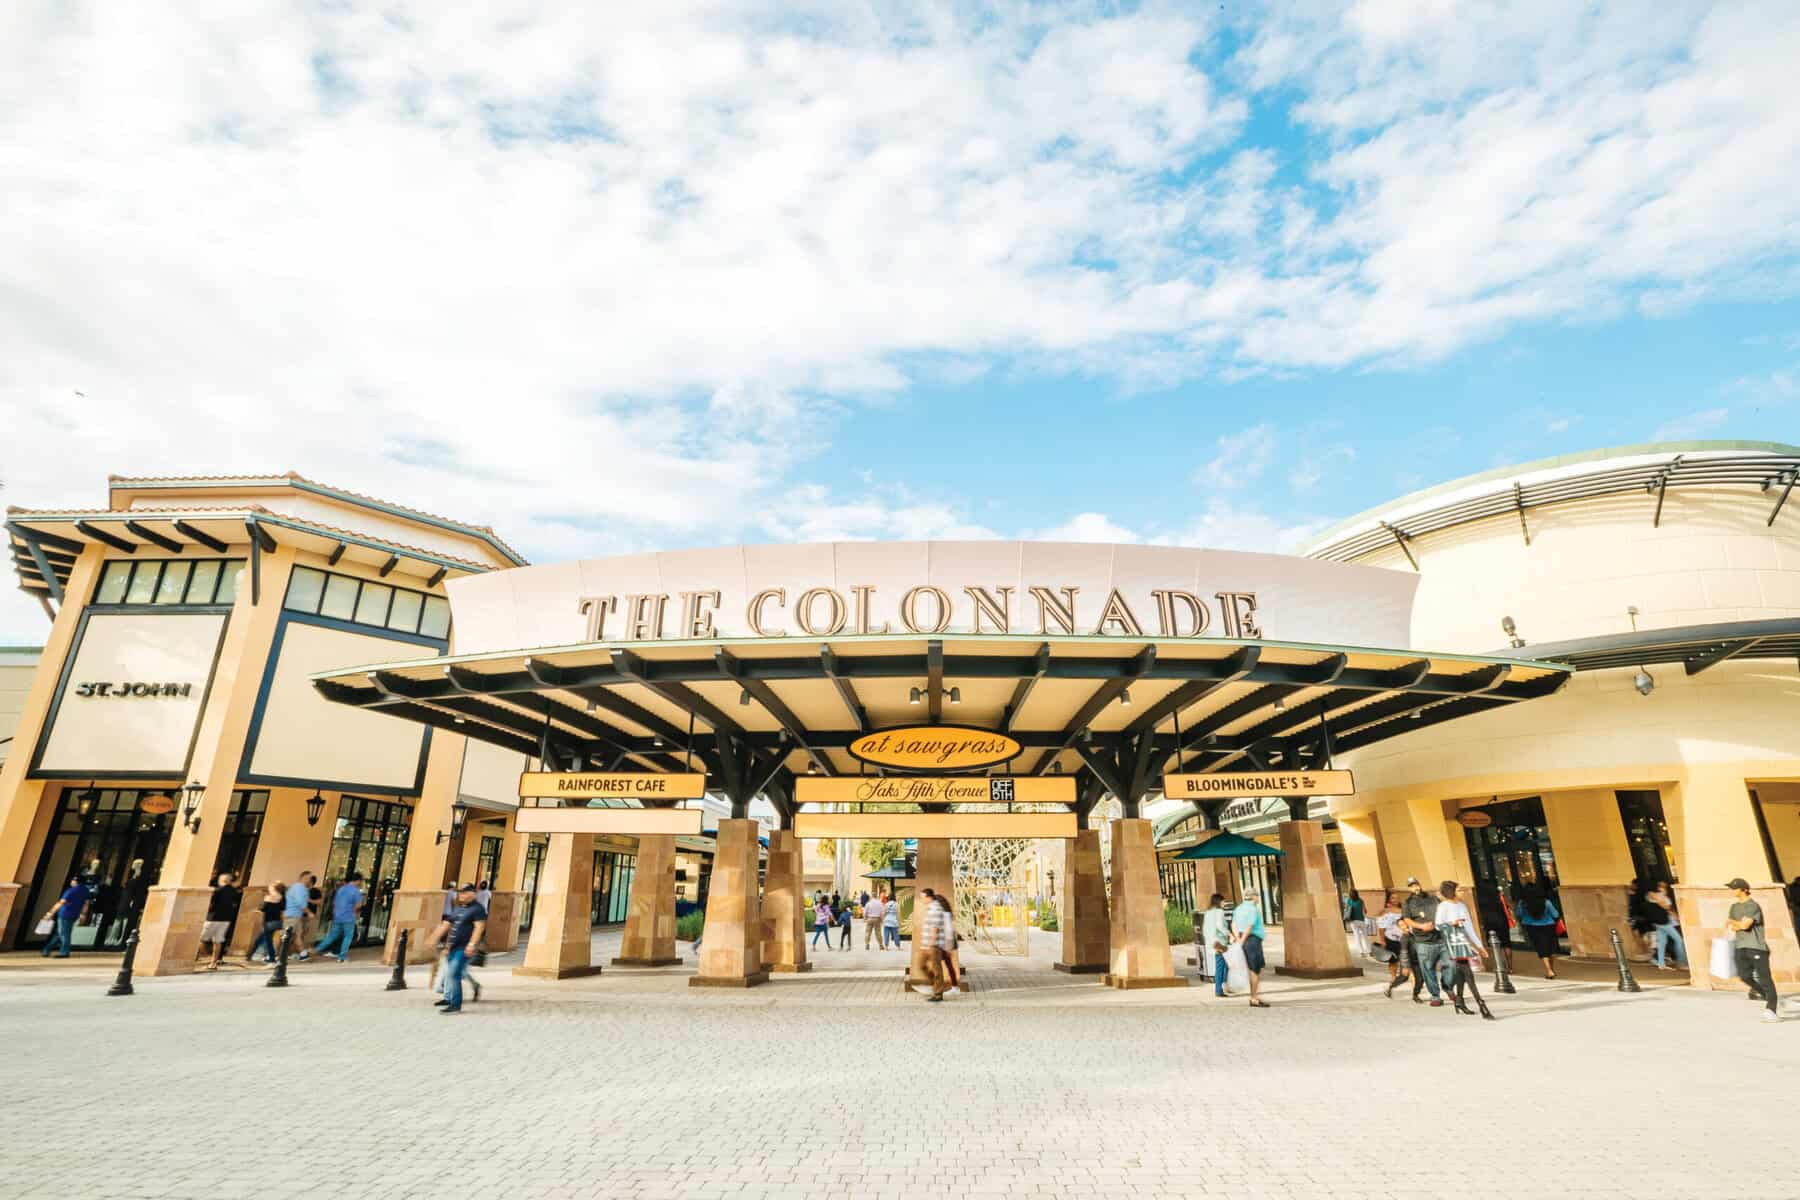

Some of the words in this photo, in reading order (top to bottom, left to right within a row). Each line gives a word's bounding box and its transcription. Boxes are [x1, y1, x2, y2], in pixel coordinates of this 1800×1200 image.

[578, 590, 722, 641] THE
[745, 584, 1263, 639] COLONNADE
[861, 735, 891, 753] at
[894, 738, 1006, 764] sawgrass
[558, 779, 633, 792] RAINFOREST
[635, 780, 665, 792] CAFE
[856, 777, 900, 801] Saks
[898, 780, 935, 801] Fifth
[934, 779, 987, 801] Avenue
[991, 781, 1013, 791] OFF
[1187, 777, 1298, 792] BLOOMINGDALE'S
